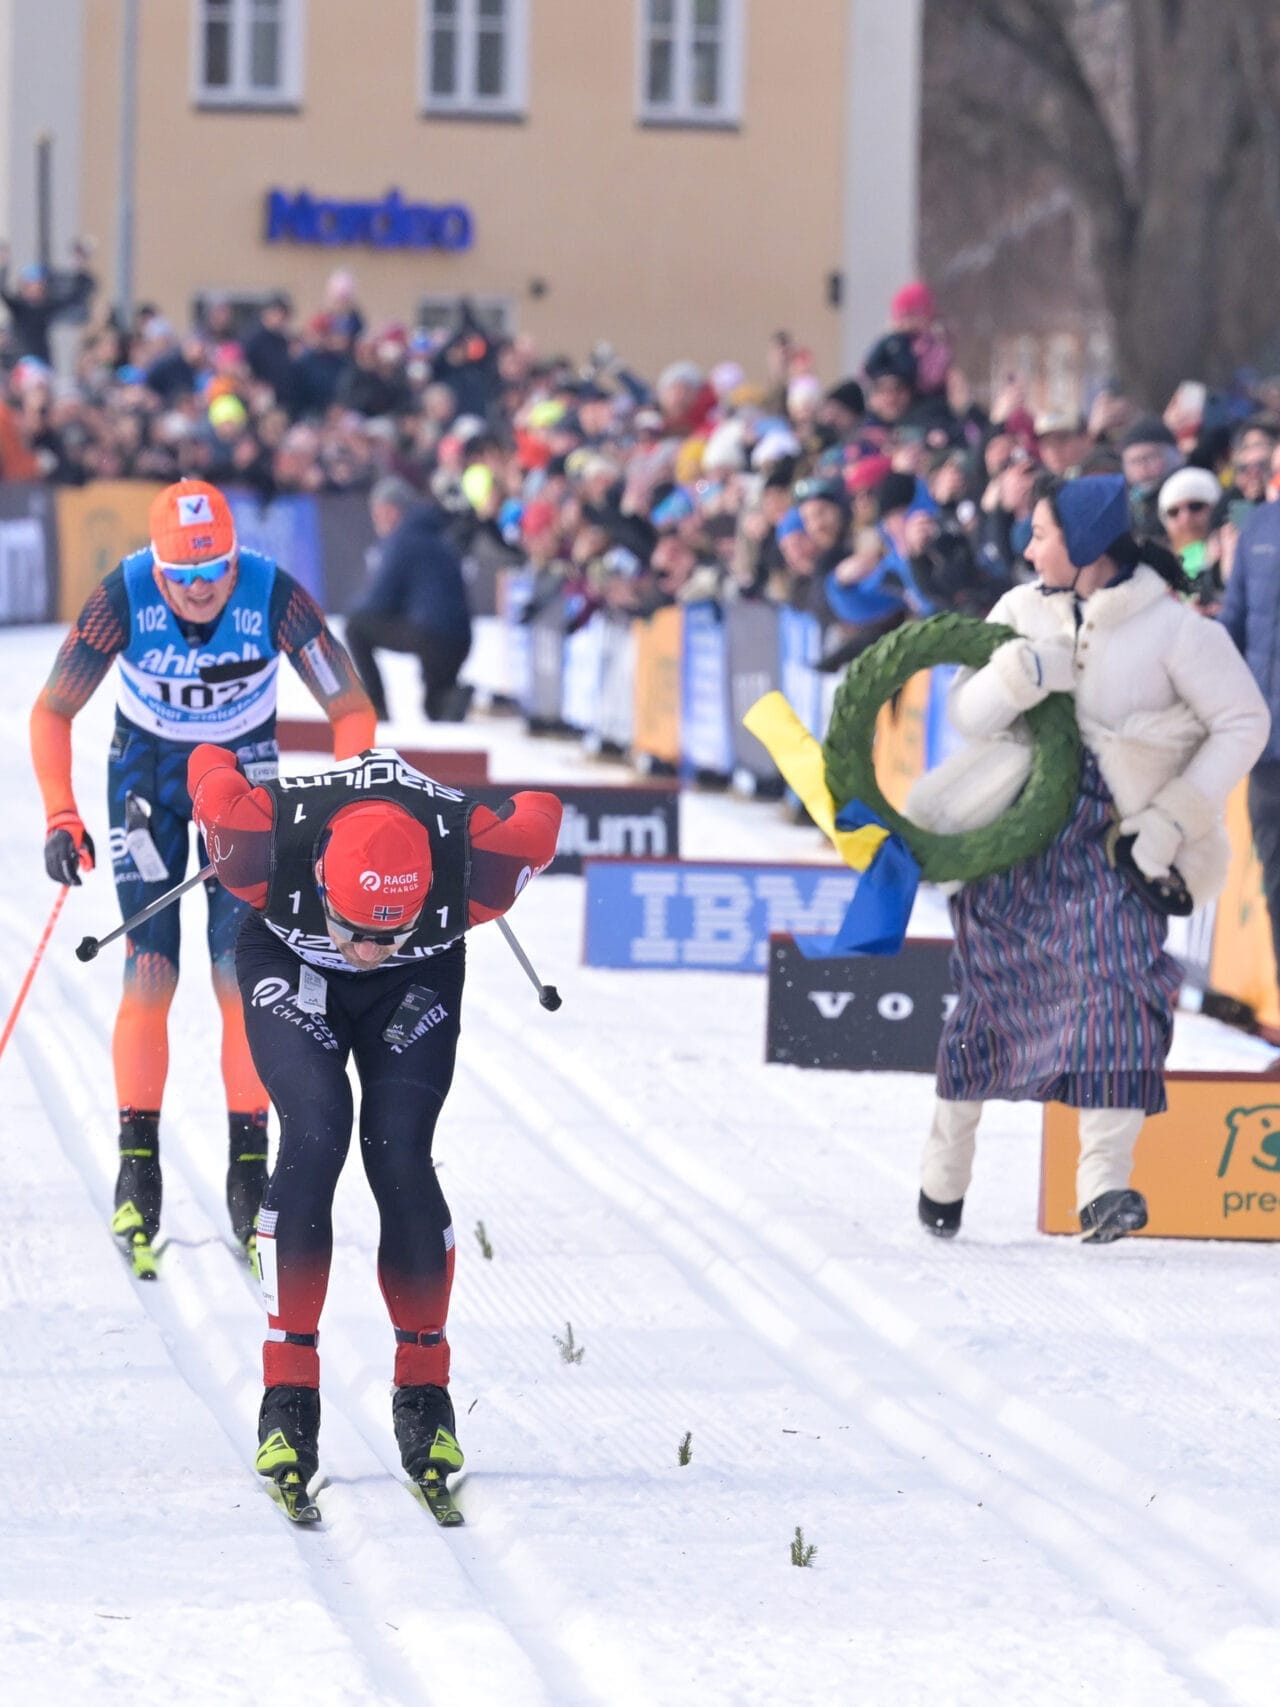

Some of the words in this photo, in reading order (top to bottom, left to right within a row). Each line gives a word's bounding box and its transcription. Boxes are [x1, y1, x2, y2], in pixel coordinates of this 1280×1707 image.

[136, 604, 167, 634] 102
[232, 606, 262, 636] 102
[383, 872, 418, 886] RAGDE
[383, 884, 419, 894] CHARGE
[288, 890, 301, 914] 1
[436, 906, 449, 928] 1
[630, 871, 858, 965] IBM
[272, 1004, 333, 1050] CHARGE
